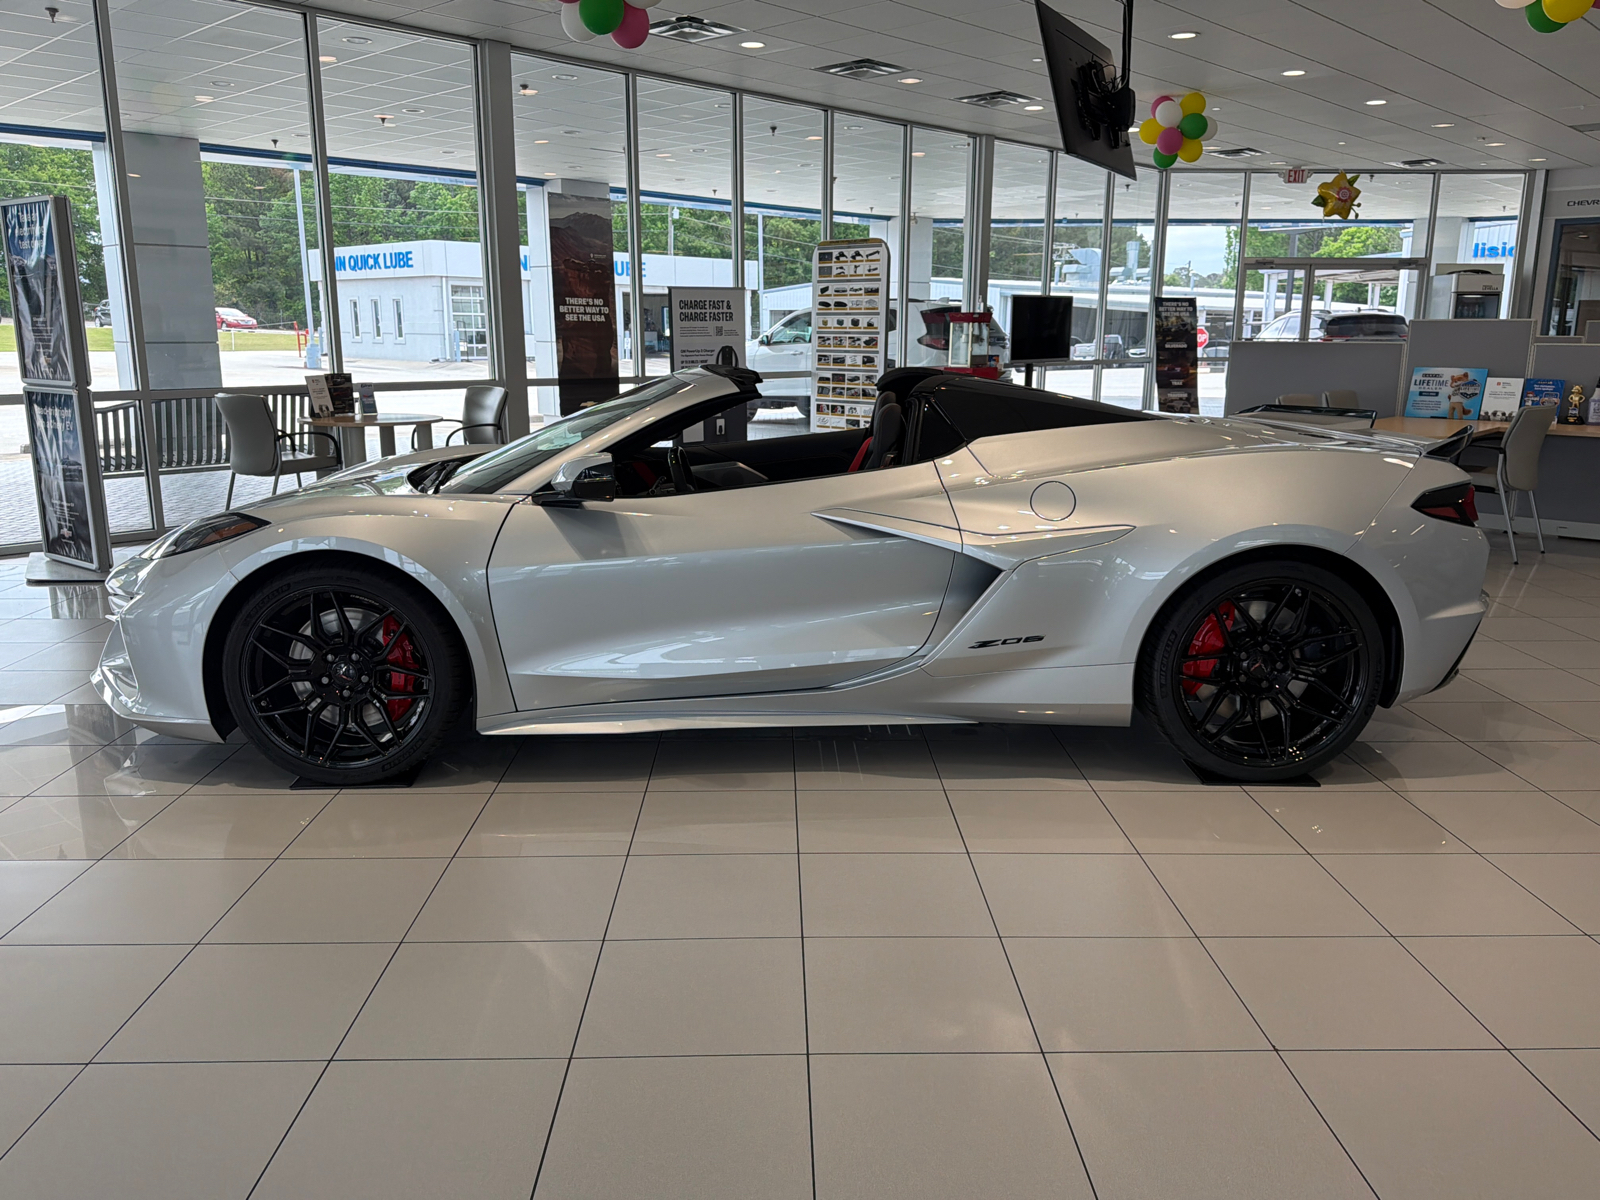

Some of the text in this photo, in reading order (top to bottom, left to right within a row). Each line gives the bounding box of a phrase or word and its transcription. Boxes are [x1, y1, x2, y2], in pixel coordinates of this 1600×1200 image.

[1287, 169, 1306, 183] EXIT
[348, 253, 382, 272] QUICK
[383, 250, 414, 270] LUBE
[565, 297, 604, 306] THERE'S NO
[679, 300, 732, 310] CHARGE FAST &
[560, 305, 585, 313] BETTER
[585, 306, 601, 314] WAY
[565, 314, 605, 322] SEE THE USA
[679, 312, 734, 322] CHARGE FASTER
[1413, 379, 1450, 387] LIFETIME
[968, 635, 1046, 649] Z06
